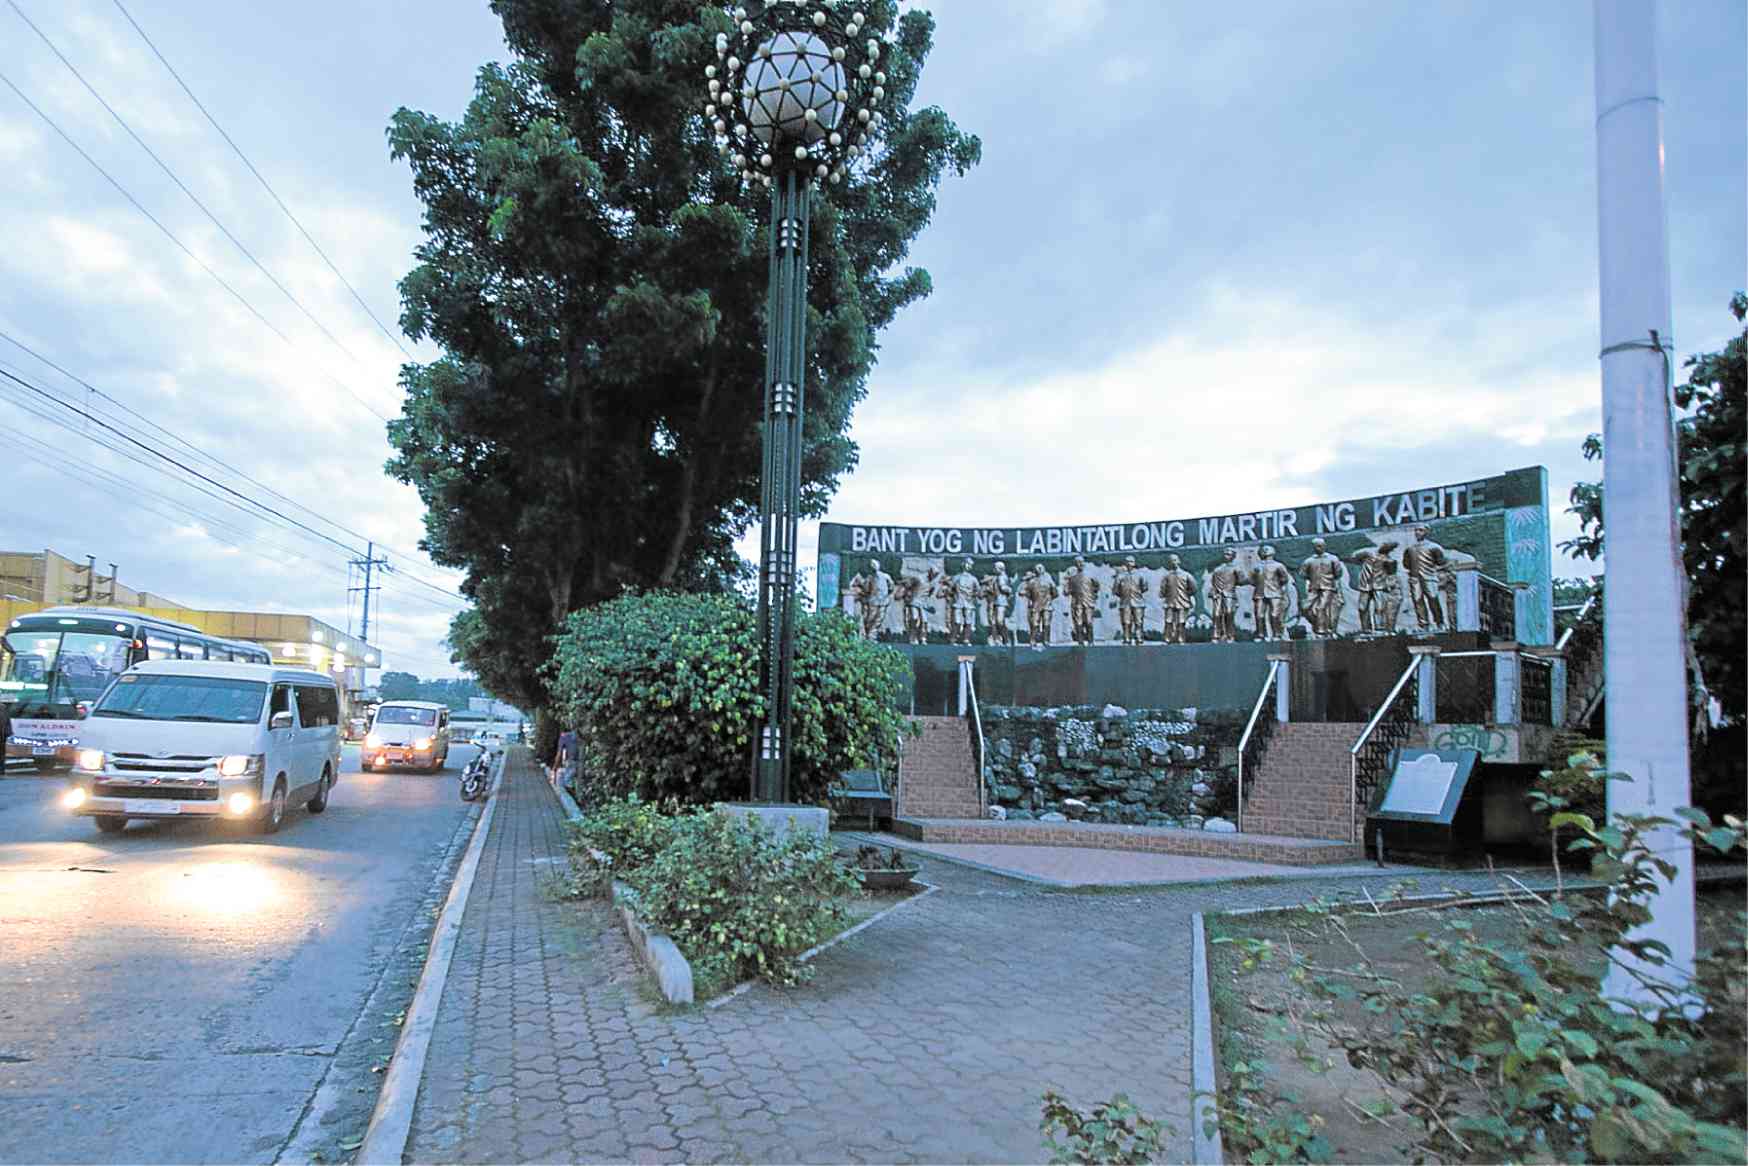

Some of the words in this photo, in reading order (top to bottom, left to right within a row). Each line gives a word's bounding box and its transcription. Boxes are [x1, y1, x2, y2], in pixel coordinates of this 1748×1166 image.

[973, 530, 1004, 554] NG
[1016, 522, 1184, 554] LABINTATLONG
[1200, 510, 1298, 545] MARTIR
[1316, 503, 1356, 533] NG
[1373, 482, 1487, 526] KABITE
